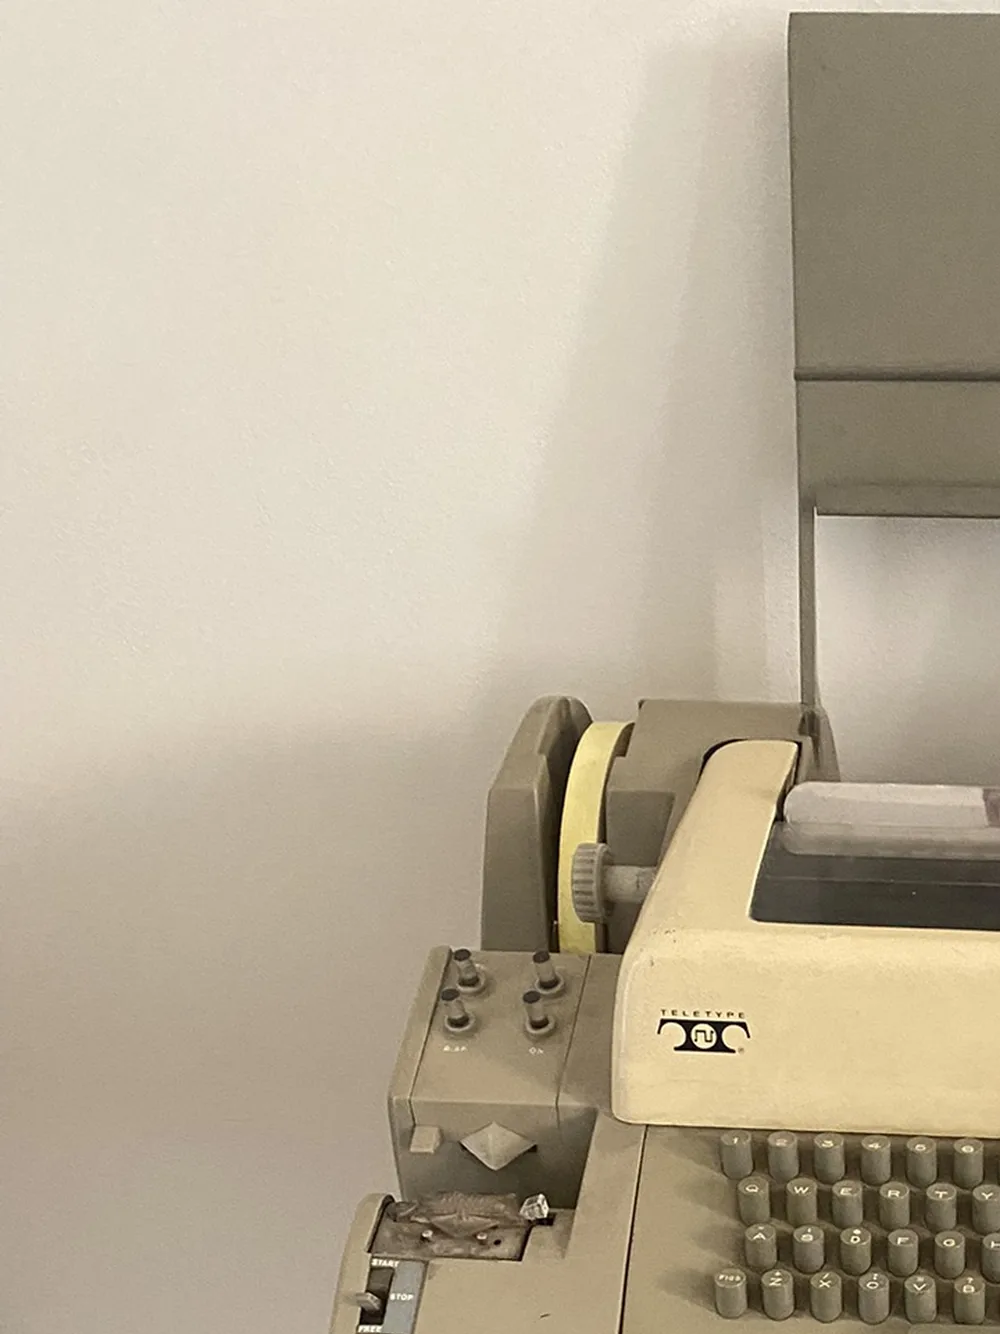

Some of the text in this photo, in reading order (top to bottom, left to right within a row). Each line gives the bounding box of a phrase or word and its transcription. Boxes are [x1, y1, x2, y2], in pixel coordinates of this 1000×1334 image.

[660, 1008, 746, 1019] TELETYPE
[794, 1186, 809, 1194] W
[888, 1190, 900, 1198] R
[934, 1190, 948, 1198] T
[981, 1192, 994, 1200] Y
[752, 1232, 766, 1240] A
[370, 1258, 400, 1268] START
[768, 1277, 782, 1286] Z
[818, 1280, 832, 1288] X
[390, 1292, 414, 1301] STOP
